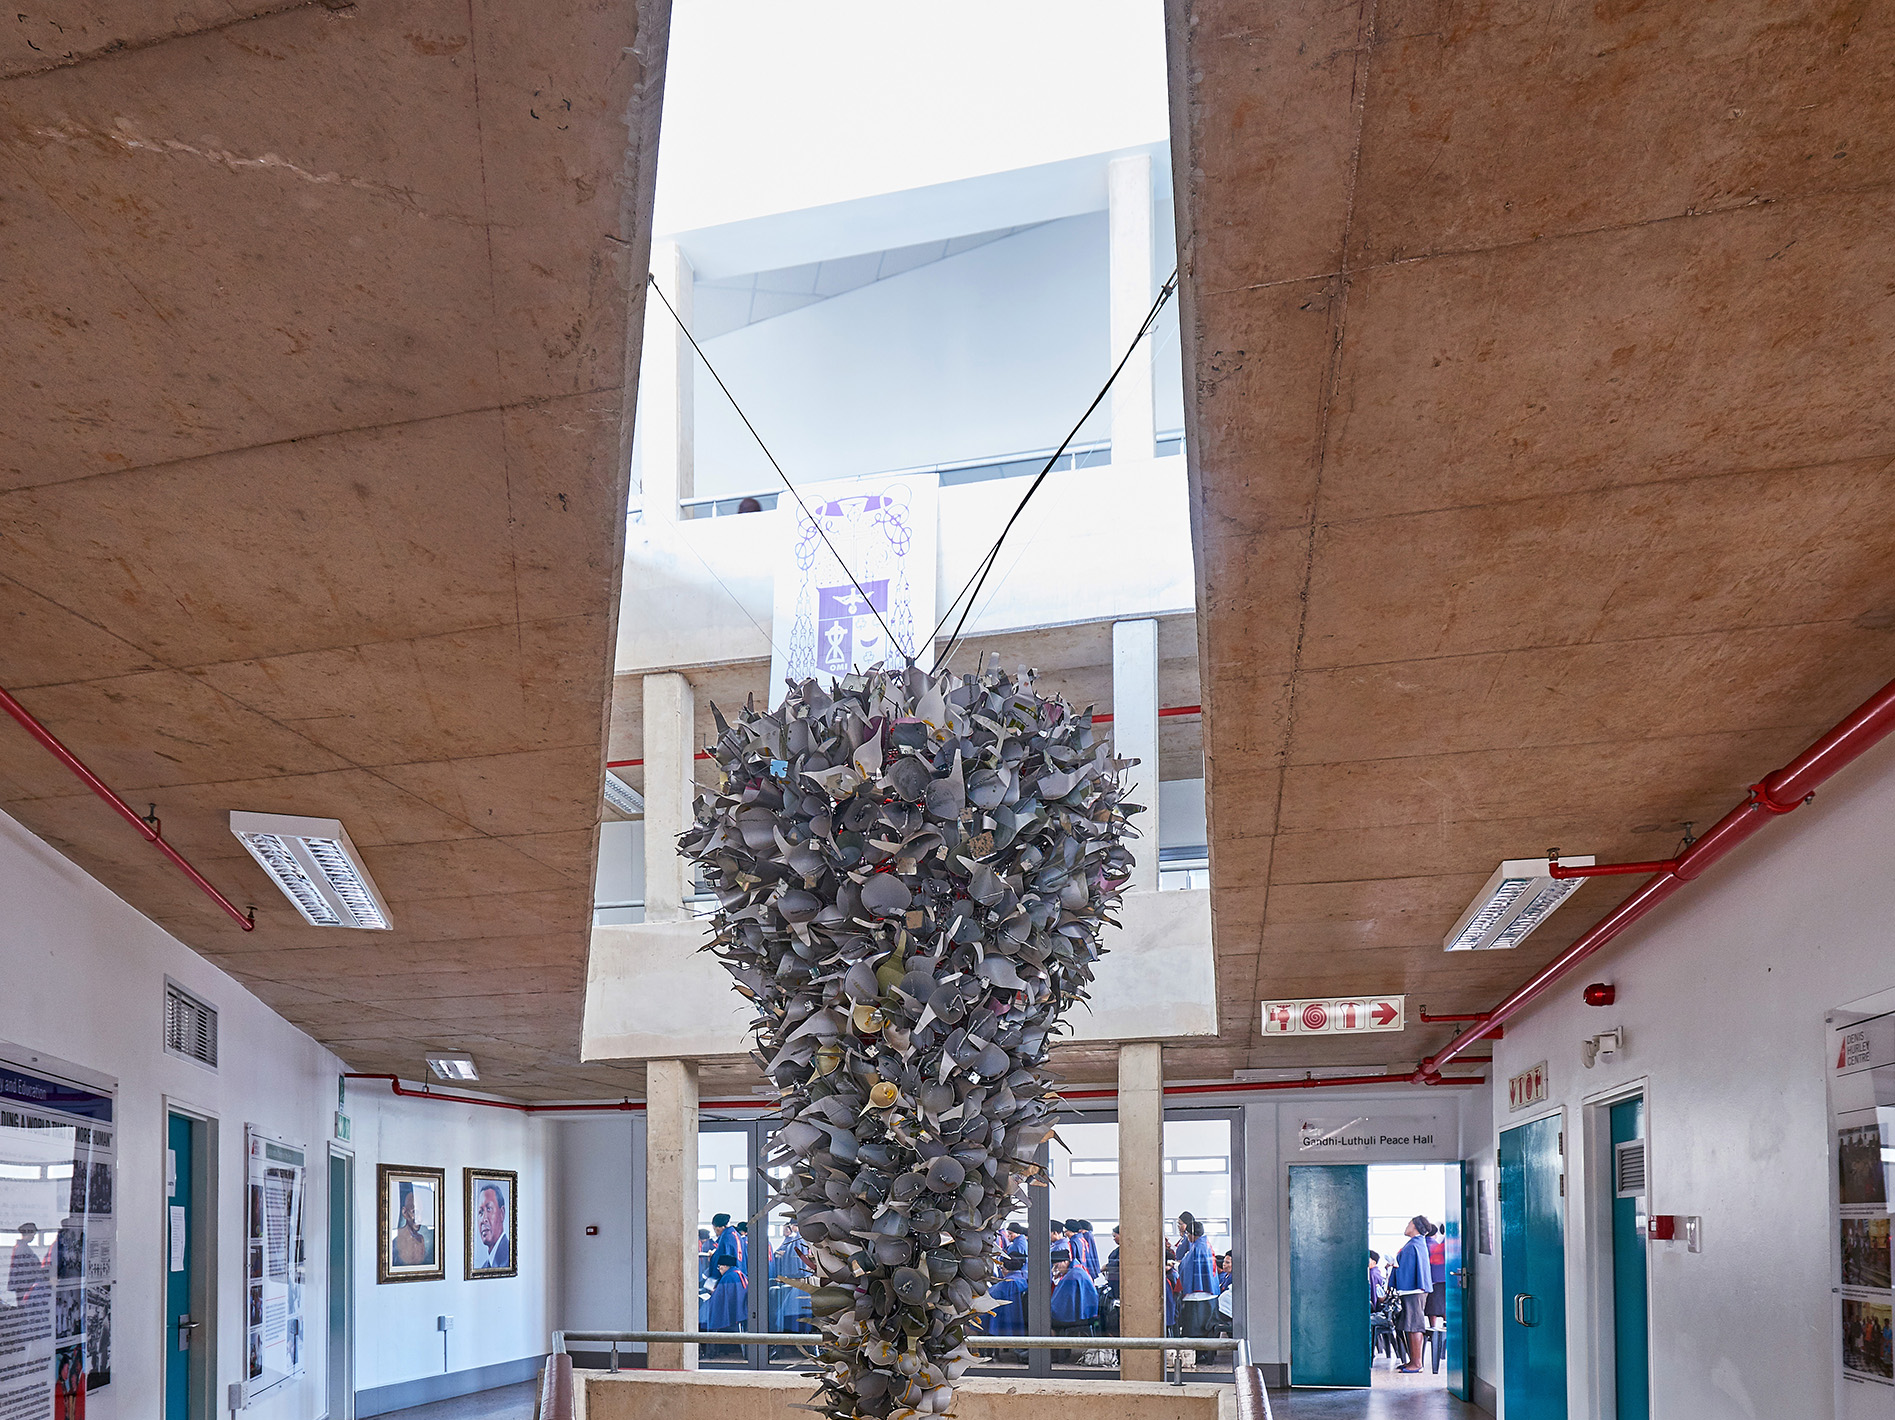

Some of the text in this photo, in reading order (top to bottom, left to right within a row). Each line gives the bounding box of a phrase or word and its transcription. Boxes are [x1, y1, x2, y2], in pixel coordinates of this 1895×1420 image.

[829, 663, 848, 672] OMI
[1847, 1031, 1864, 1044] DENIS
[1847, 1041, 1870, 1055] HURLEY
[1848, 1052, 1870, 1066] CENTRE
[5, 1078, 17, 1093] and
[18, 1079, 47, 1100] Education
[26, 1115, 51, 1136] WORLD
[75, 1126, 91, 1144] MORE
[1303, 1134, 1434, 1146] Gandhi-Luthuli Peace Hall
